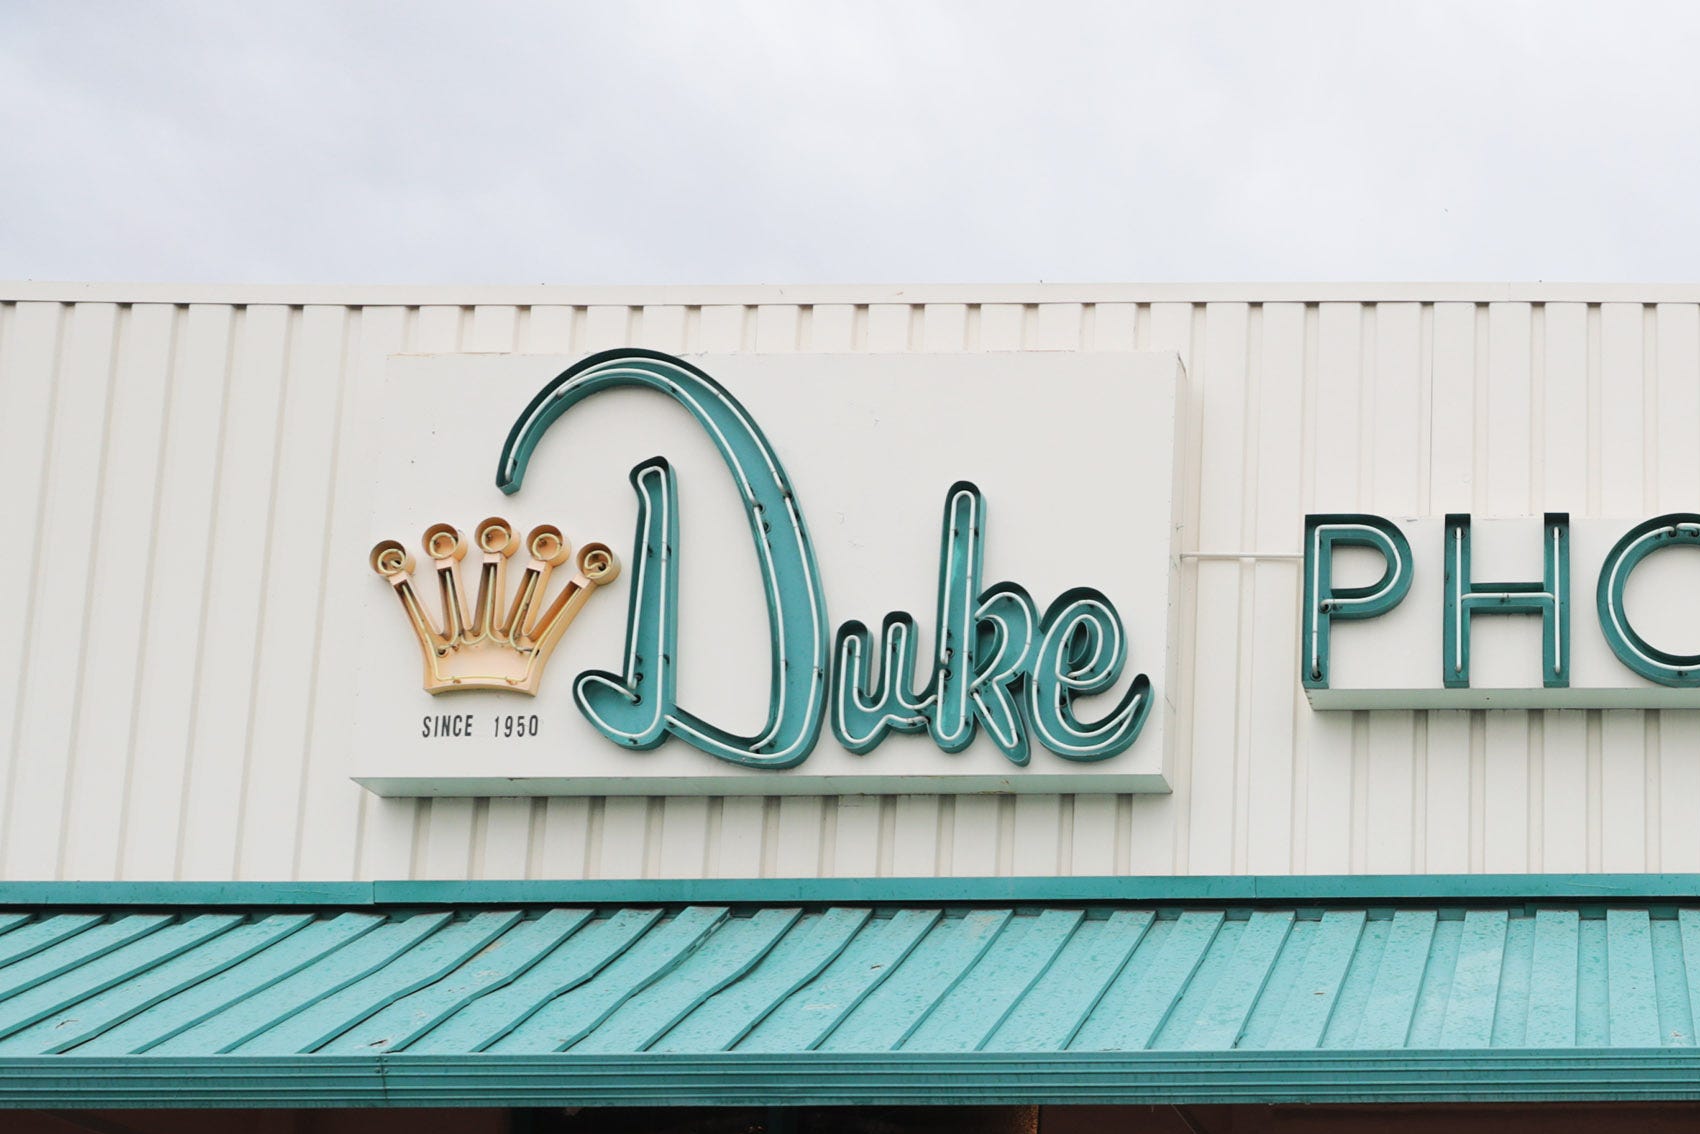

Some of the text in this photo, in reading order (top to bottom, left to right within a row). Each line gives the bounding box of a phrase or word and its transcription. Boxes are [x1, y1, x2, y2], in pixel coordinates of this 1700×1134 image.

[496, 347, 1154, 769] Duke
[422, 715, 539, 738] SINCE 1950
